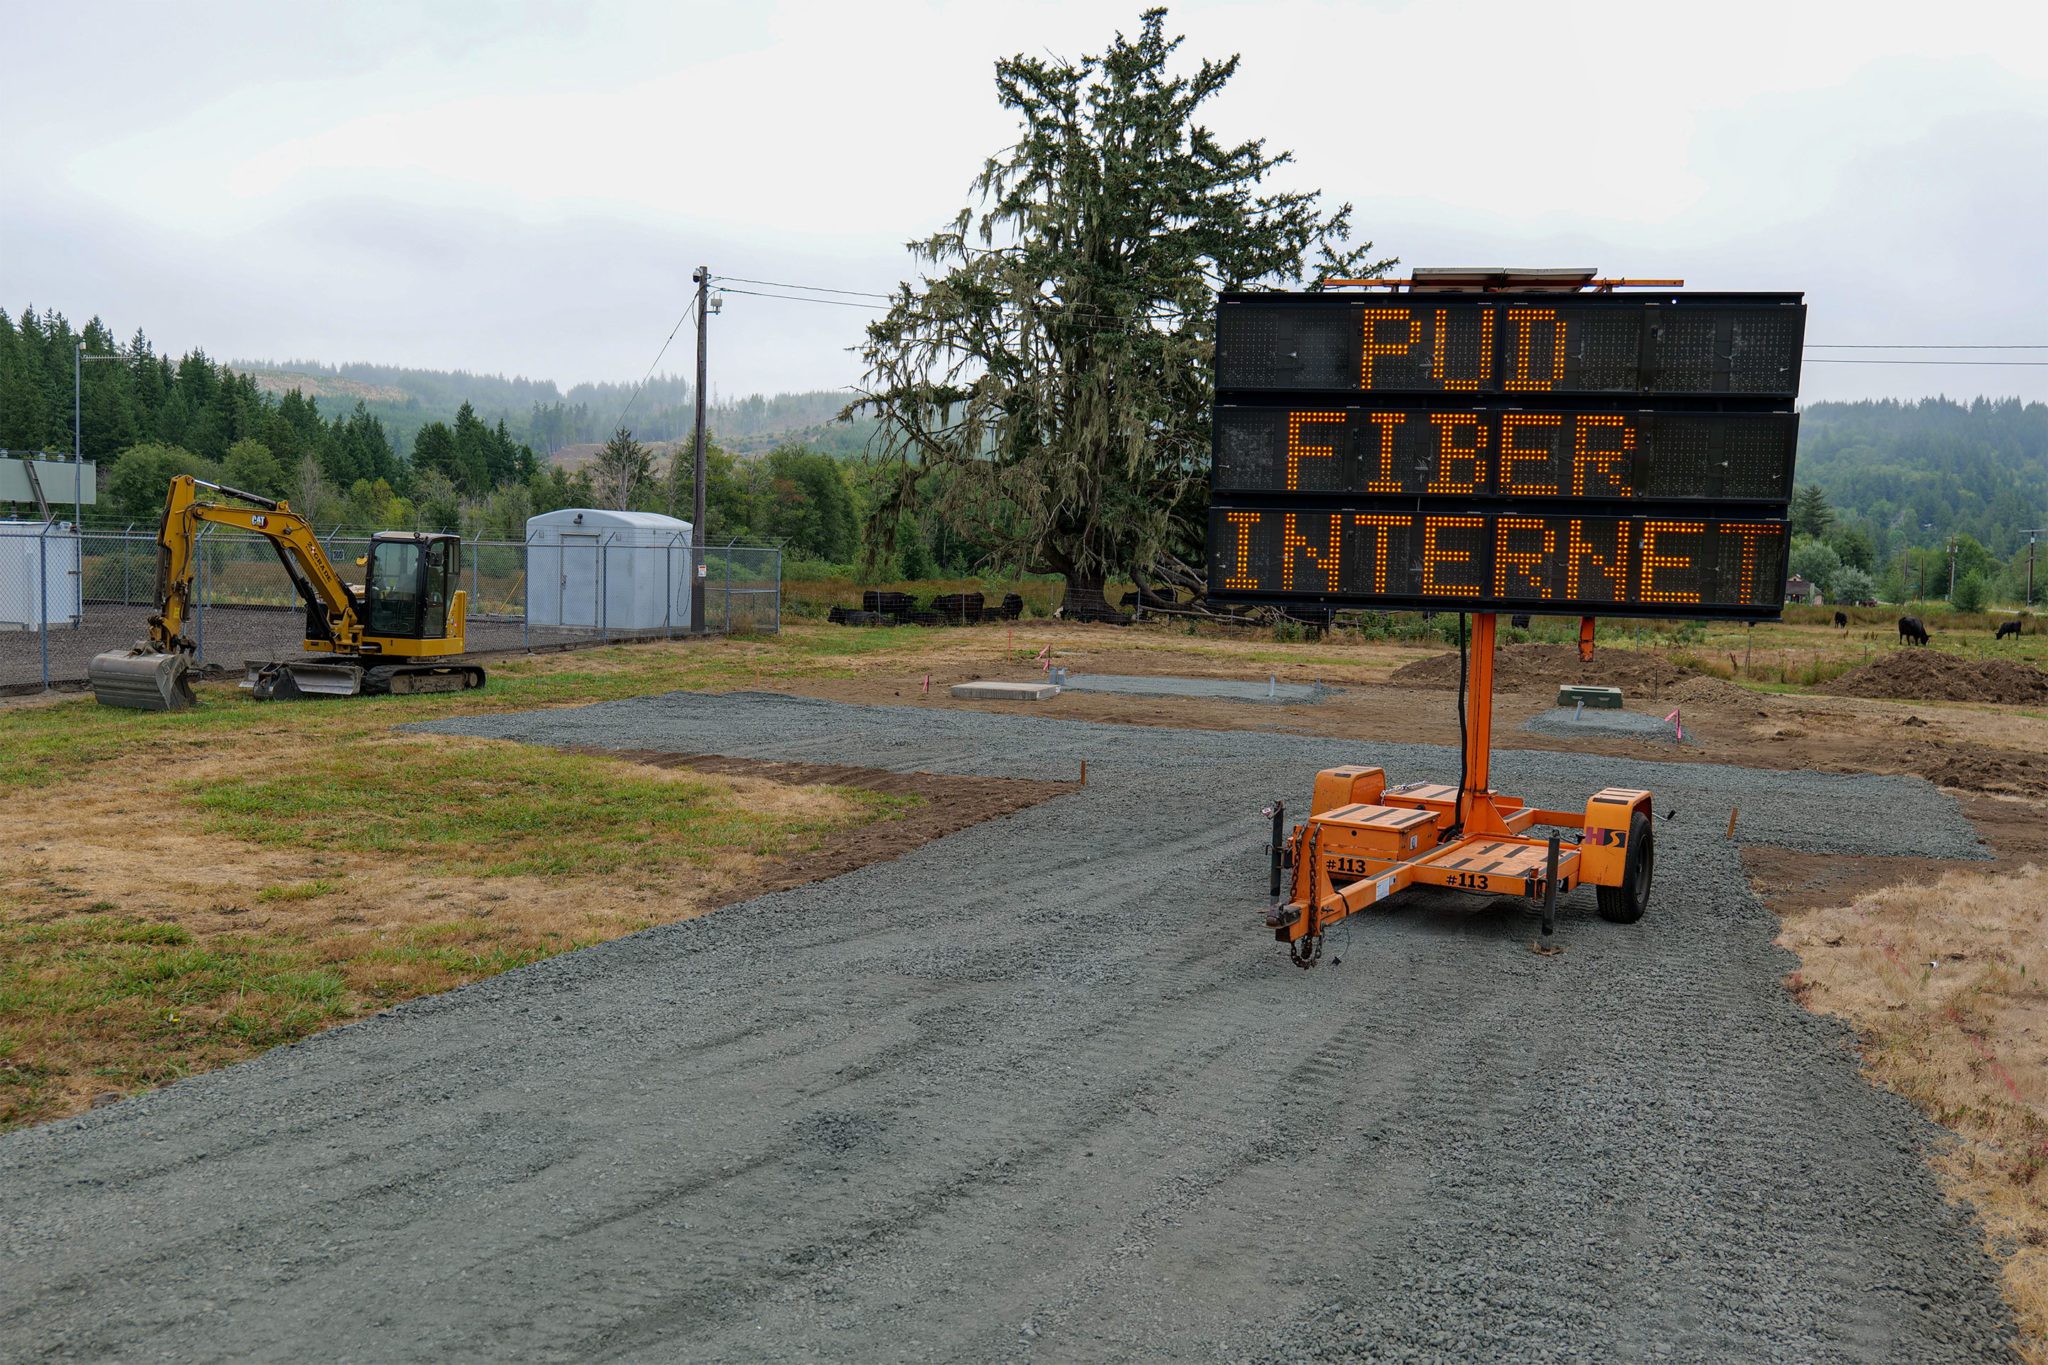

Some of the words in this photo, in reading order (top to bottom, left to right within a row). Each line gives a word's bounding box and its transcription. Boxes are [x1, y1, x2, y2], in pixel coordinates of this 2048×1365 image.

[1361, 308, 1567, 390] PUD
[1286, 411, 1636, 497] FIBER
[251, 515, 265, 526] CAT
[1225, 511, 1783, 604] INTERNET
[1326, 857, 1366, 874] #113
[1446, 872, 1489, 890] #113
